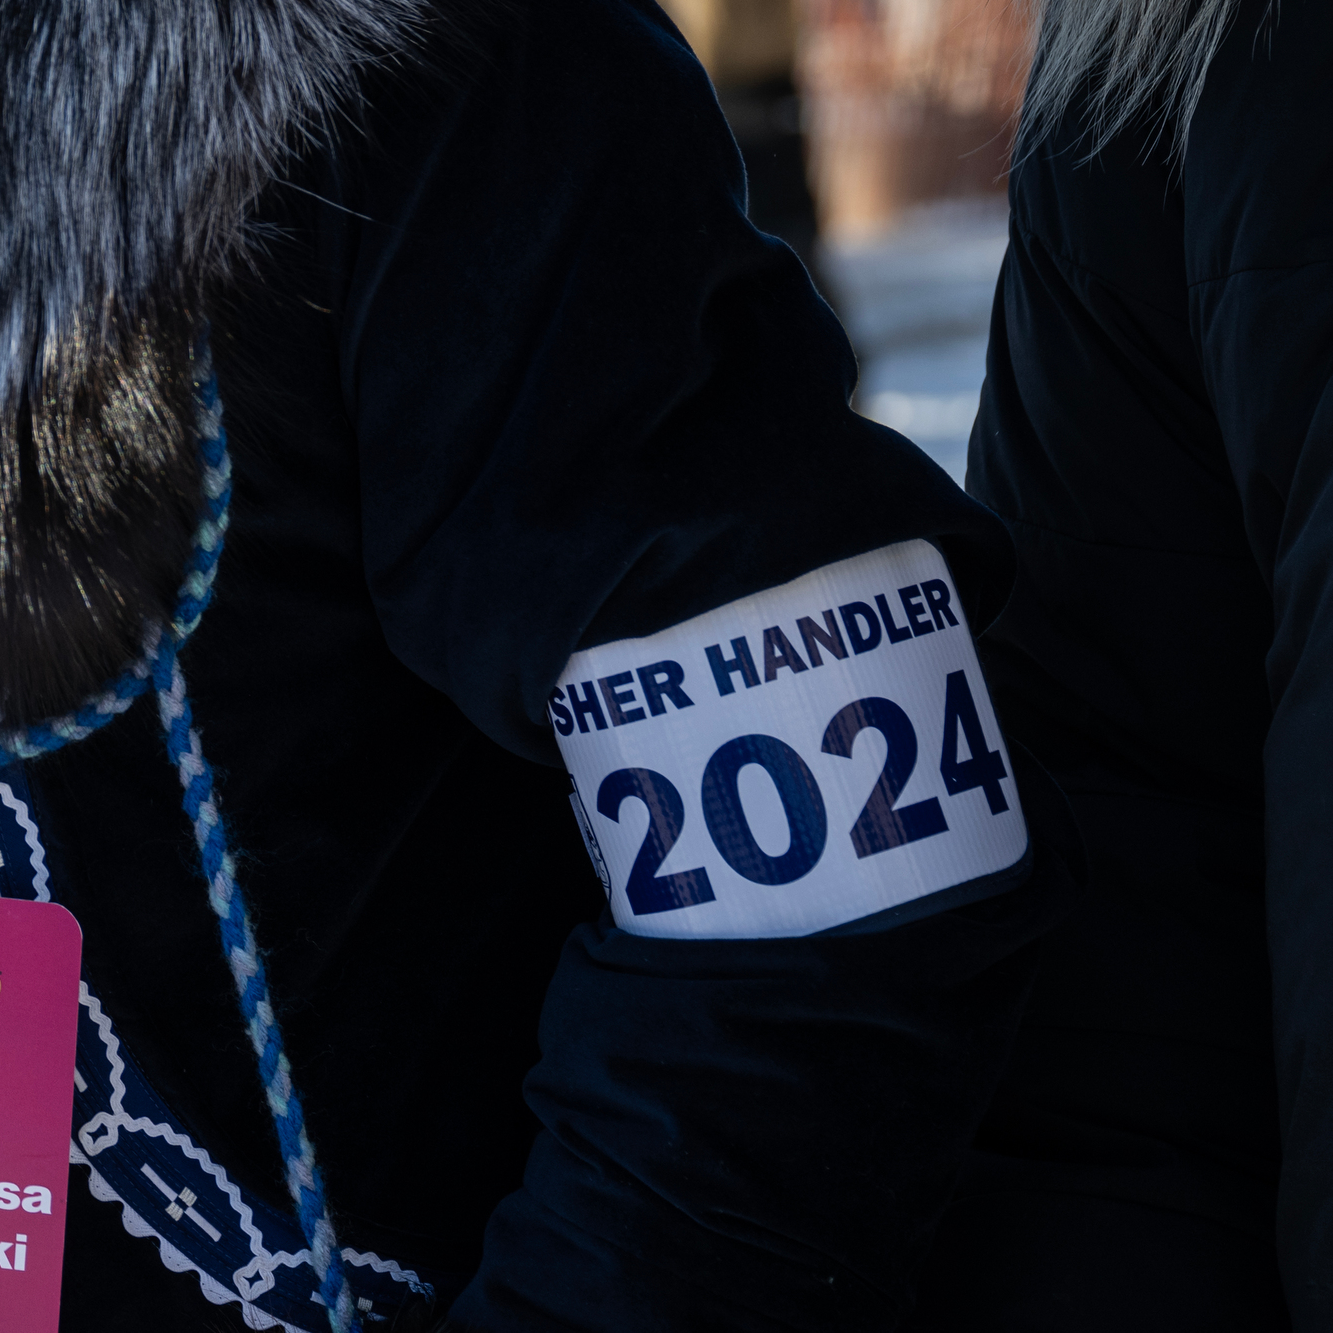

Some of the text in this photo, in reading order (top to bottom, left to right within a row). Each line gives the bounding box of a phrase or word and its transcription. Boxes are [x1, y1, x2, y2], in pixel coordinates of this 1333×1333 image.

[546, 578, 960, 736] SHER HANDLER
[596, 669, 1009, 916] 2024
